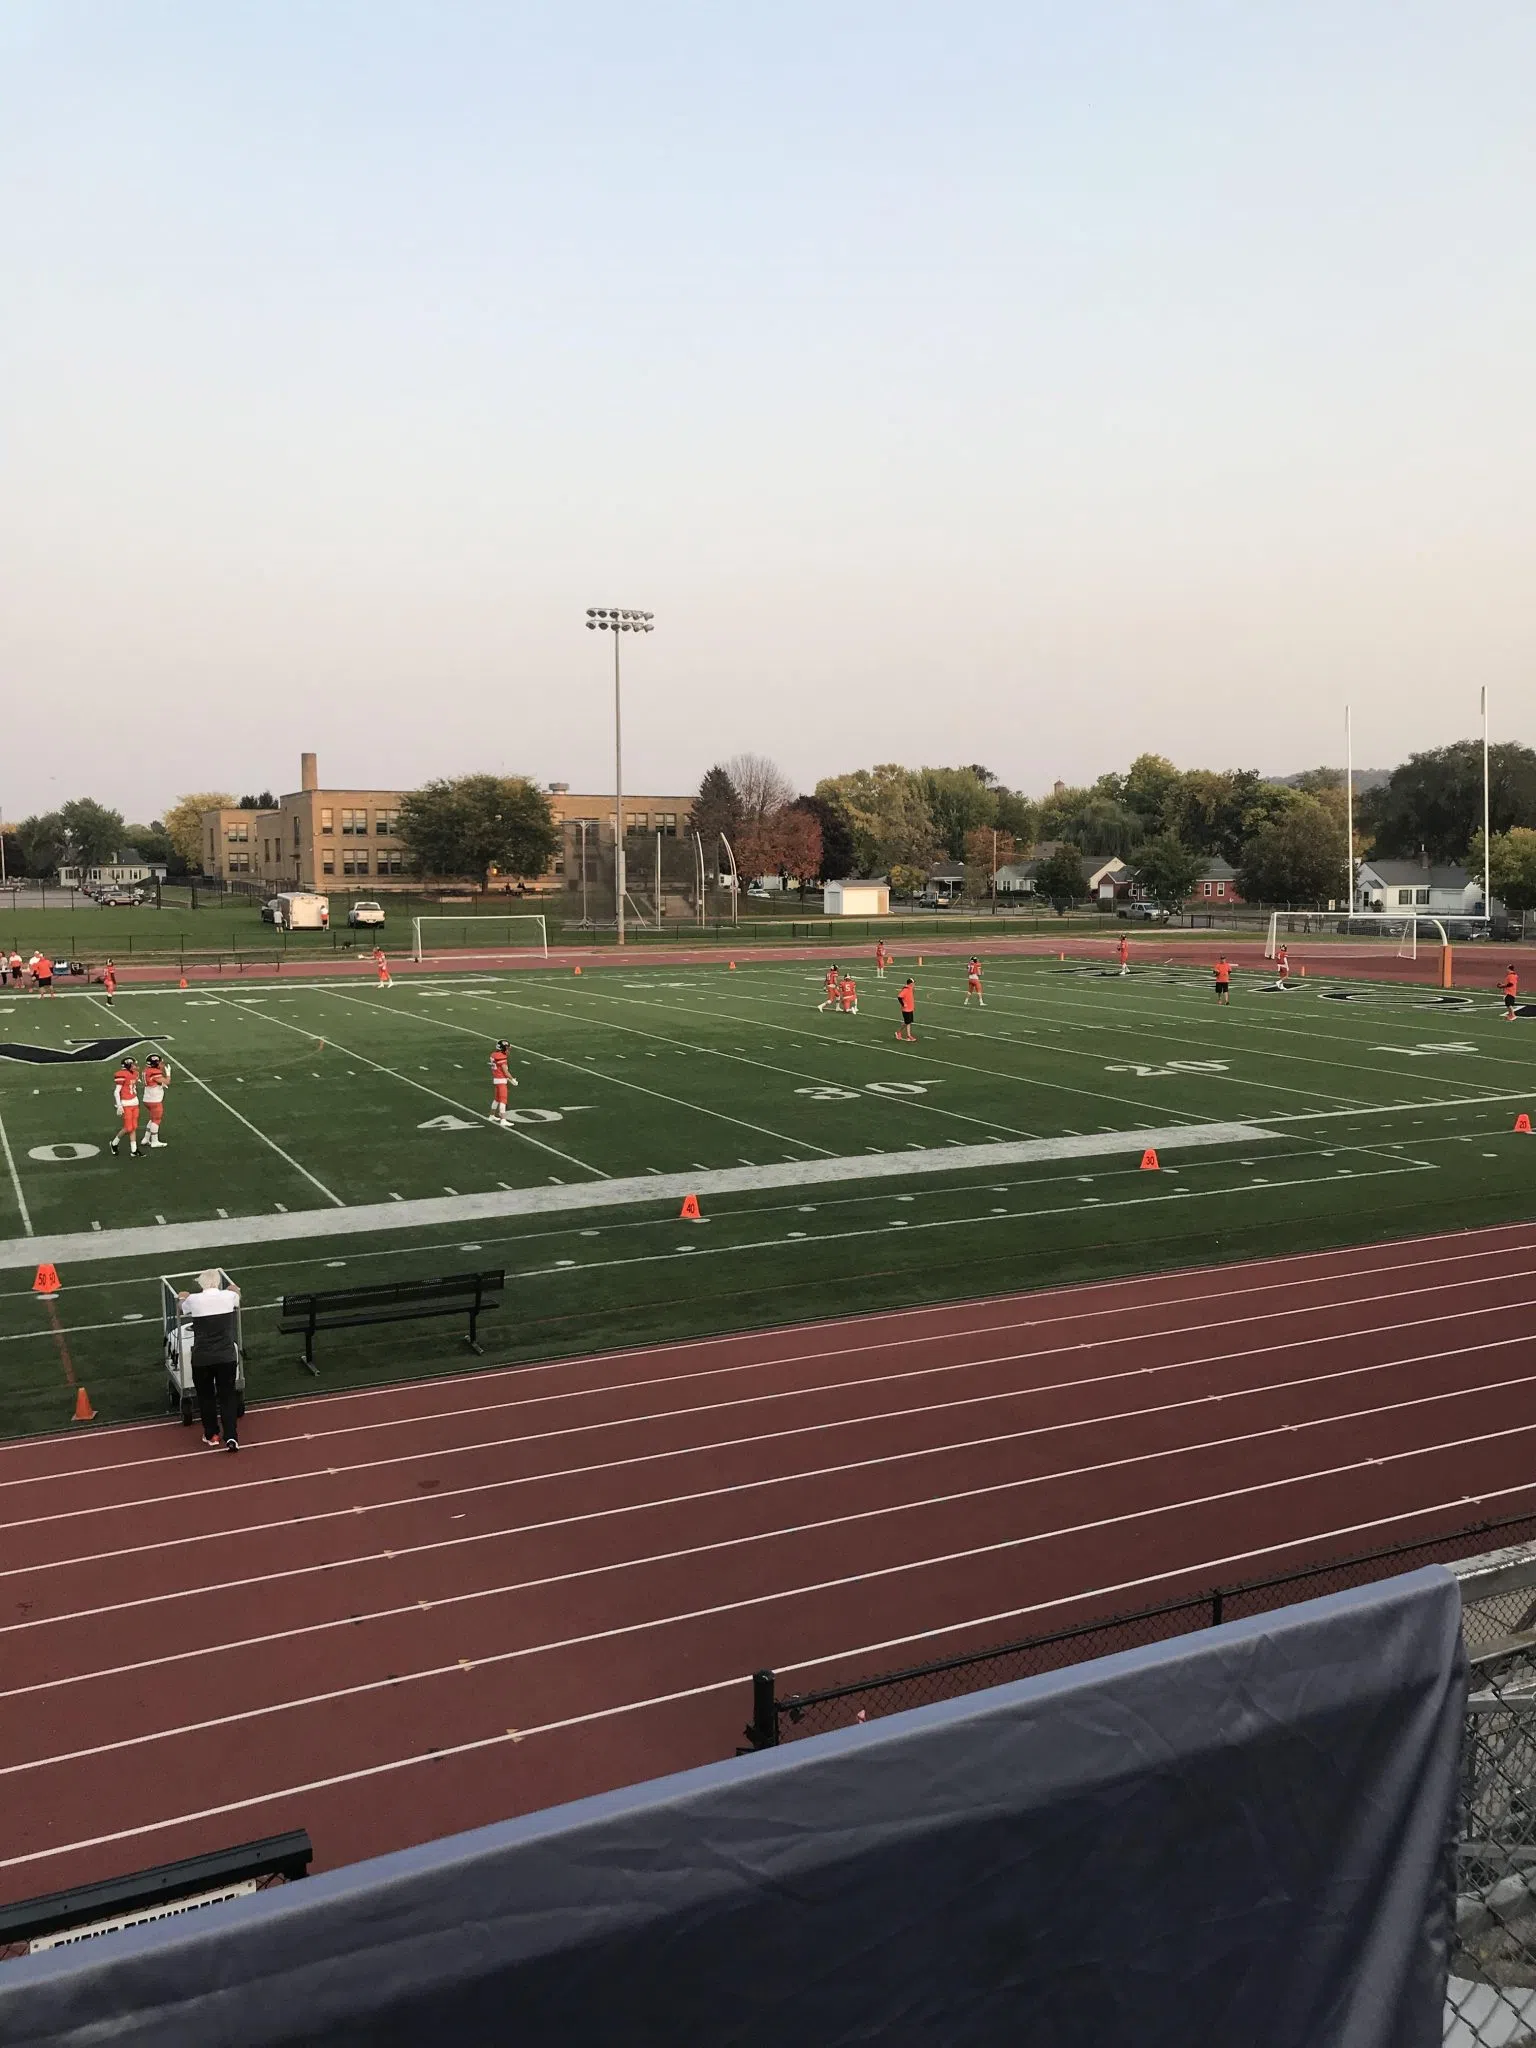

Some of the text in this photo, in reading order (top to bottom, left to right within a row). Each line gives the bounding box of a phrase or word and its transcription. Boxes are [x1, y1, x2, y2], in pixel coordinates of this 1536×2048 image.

[1103, 1060, 1230, 1077] 20
[793, 1082, 929, 1100] 30
[416, 1108, 564, 1131] 40
[1145, 1155, 1155, 1166] 30
[686, 1203, 695, 1214] 40
